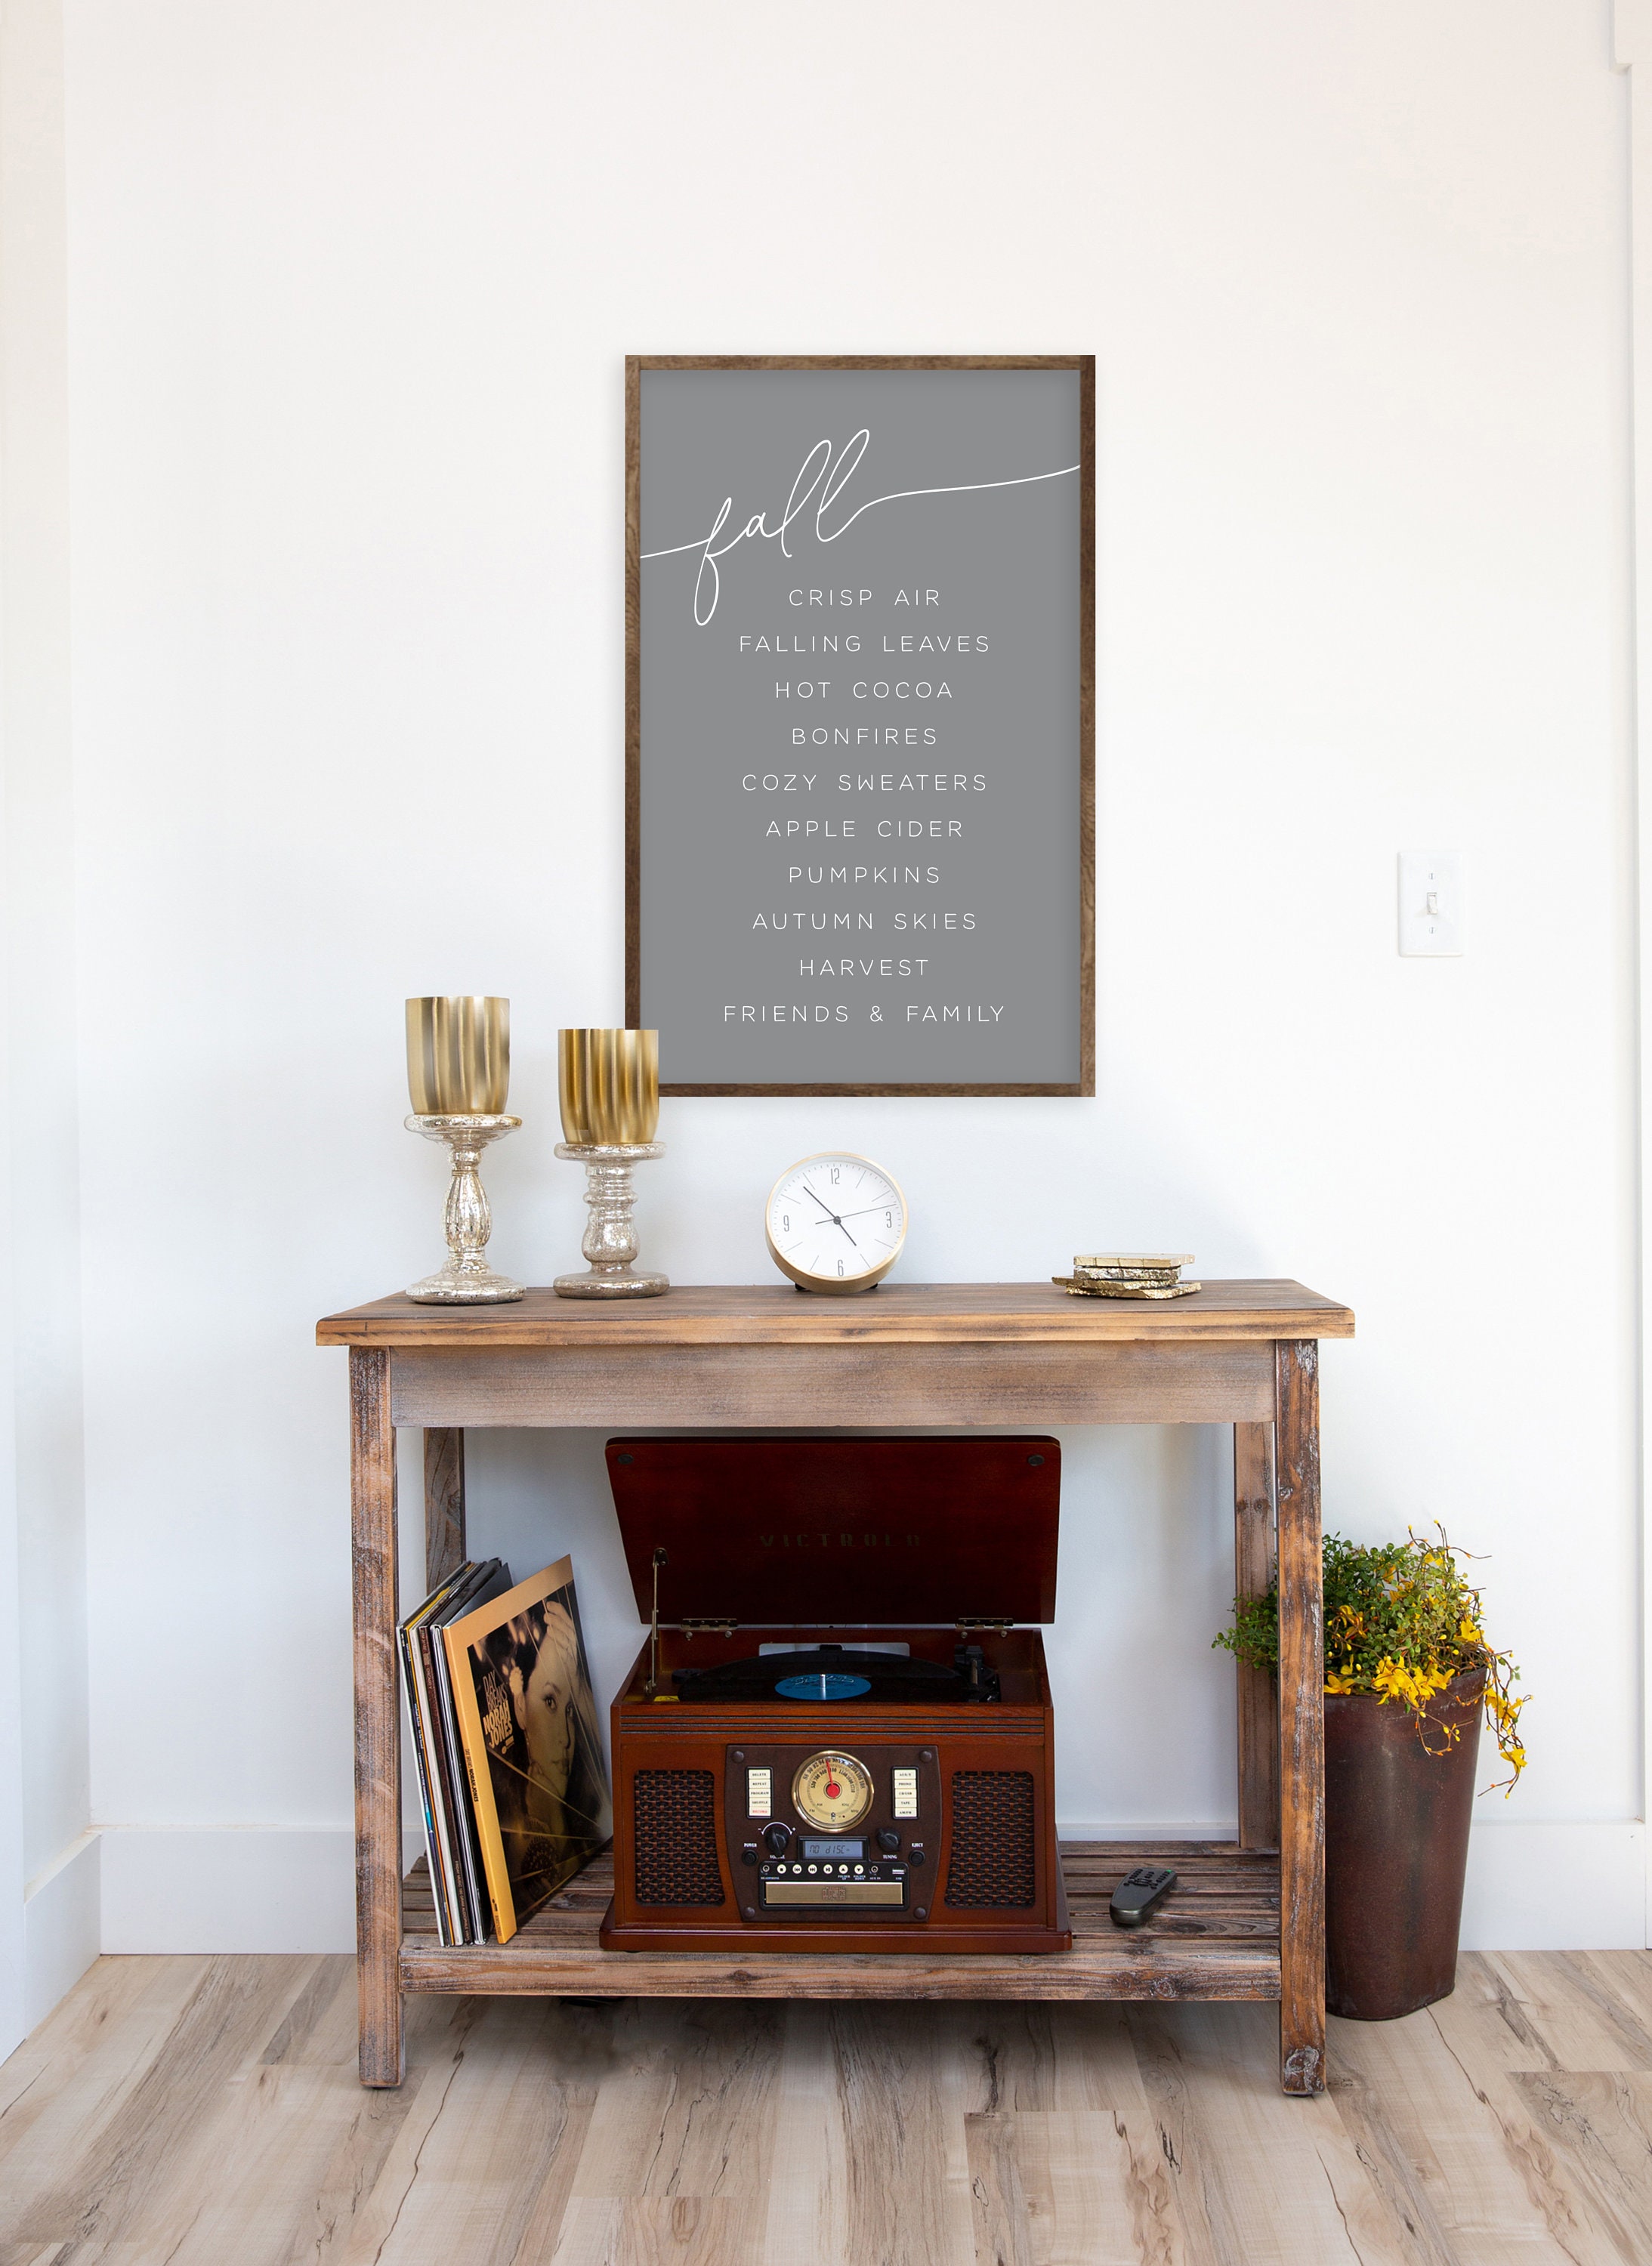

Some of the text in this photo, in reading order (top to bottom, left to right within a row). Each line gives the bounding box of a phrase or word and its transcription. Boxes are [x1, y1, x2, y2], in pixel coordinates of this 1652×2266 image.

[789, 589, 940, 607] CRISP AIR
[740, 635, 989, 653] FALLING LEAVES
[776, 681, 953, 699] HOT COCOA
[792, 727, 937, 745] BONFIRES
[742, 773, 986, 792] COZY SWEATERS
[765, 820, 962, 838] APPLE CIDER
[789, 866, 940, 884] PUMPKINS
[752, 912, 976, 930] AUTUMN SKIES
[800, 959, 929, 977] HARVEST
[724, 1005, 1004, 1023] FRIENDS & FAMILY
[830, 1168, 840, 1185] 12
[783, 1215, 789, 1232] 9
[885, 1212, 892, 1228] 3
[838, 1260, 844, 1277] 6
[483, 1669, 496, 1693] DAY
[486, 1683, 508, 1713] BREAKS
[483, 1700, 511, 1735] NORAH
[489, 1722, 513, 1749] JONES
